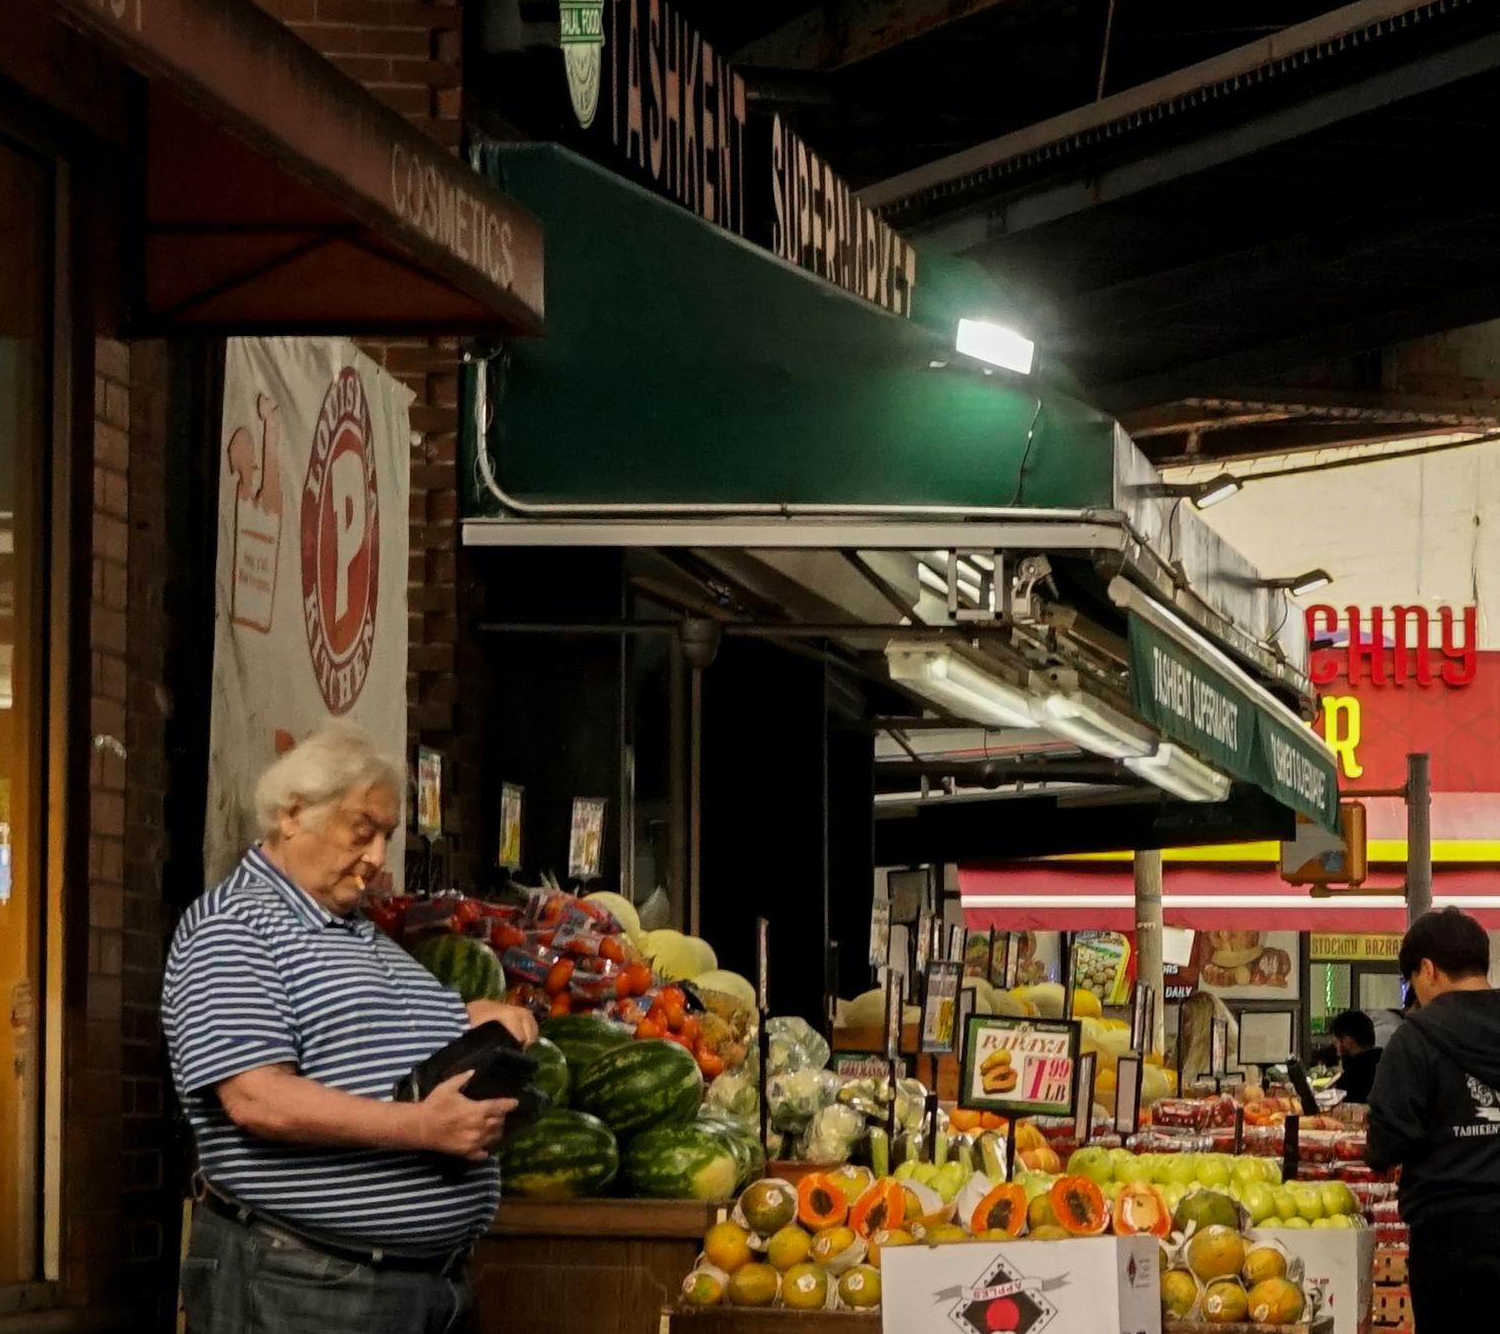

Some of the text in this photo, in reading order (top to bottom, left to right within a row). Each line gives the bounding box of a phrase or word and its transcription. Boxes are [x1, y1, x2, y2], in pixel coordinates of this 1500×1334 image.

[391, 143, 514, 293] COSMETICS
[772, 112, 916, 319] SUPERMARKET
[1165, 987, 1192, 998] DAILY
[981, 1034, 1067, 1054] PAPAYA
[1044, 1083, 1066, 1102] LB
[973, 1279, 1022, 1299] APPLES
